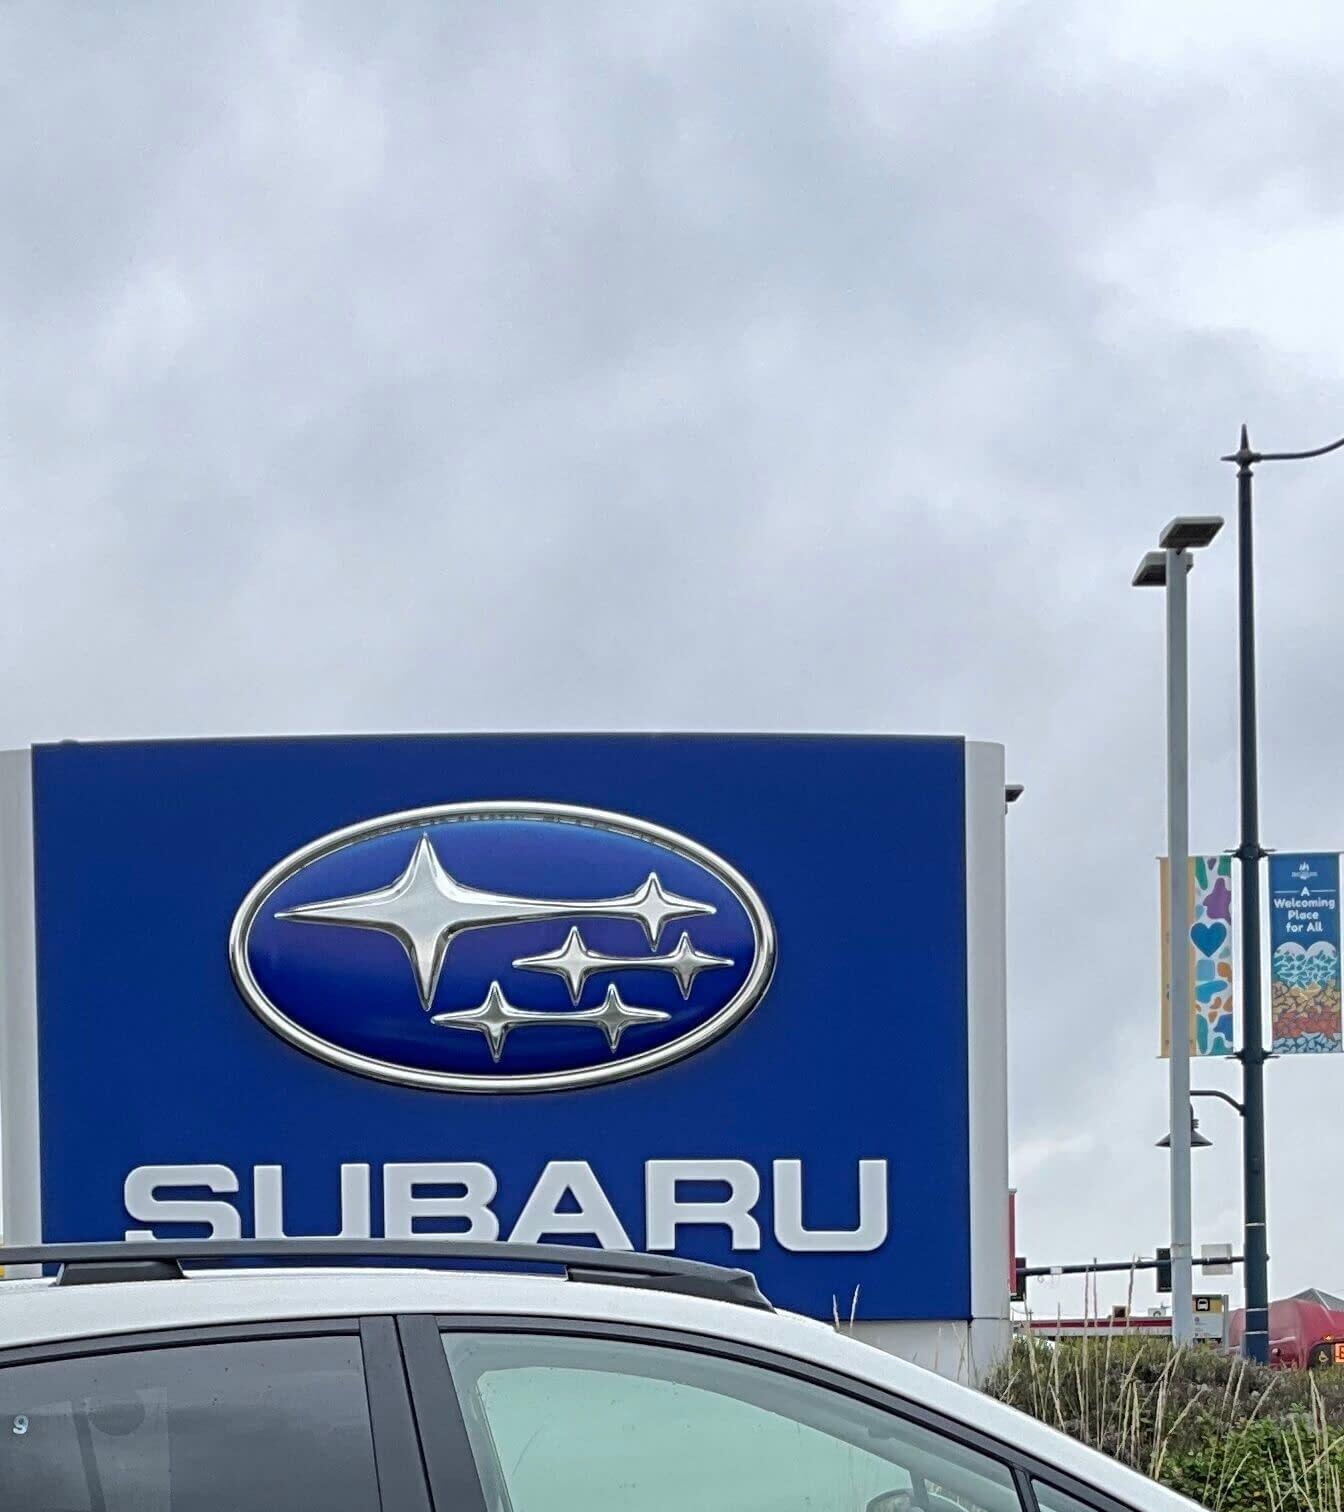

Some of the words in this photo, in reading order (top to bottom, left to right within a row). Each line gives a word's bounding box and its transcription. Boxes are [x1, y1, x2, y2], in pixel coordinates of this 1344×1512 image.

[1300, 886, 1311, 897] A
[1274, 897, 1336, 910] Welcoming
[1287, 909, 1320, 920] Place
[1285, 921, 1304, 933] for
[1306, 921, 1324, 932] All
[124, 1159, 888, 1251] SUBARU
